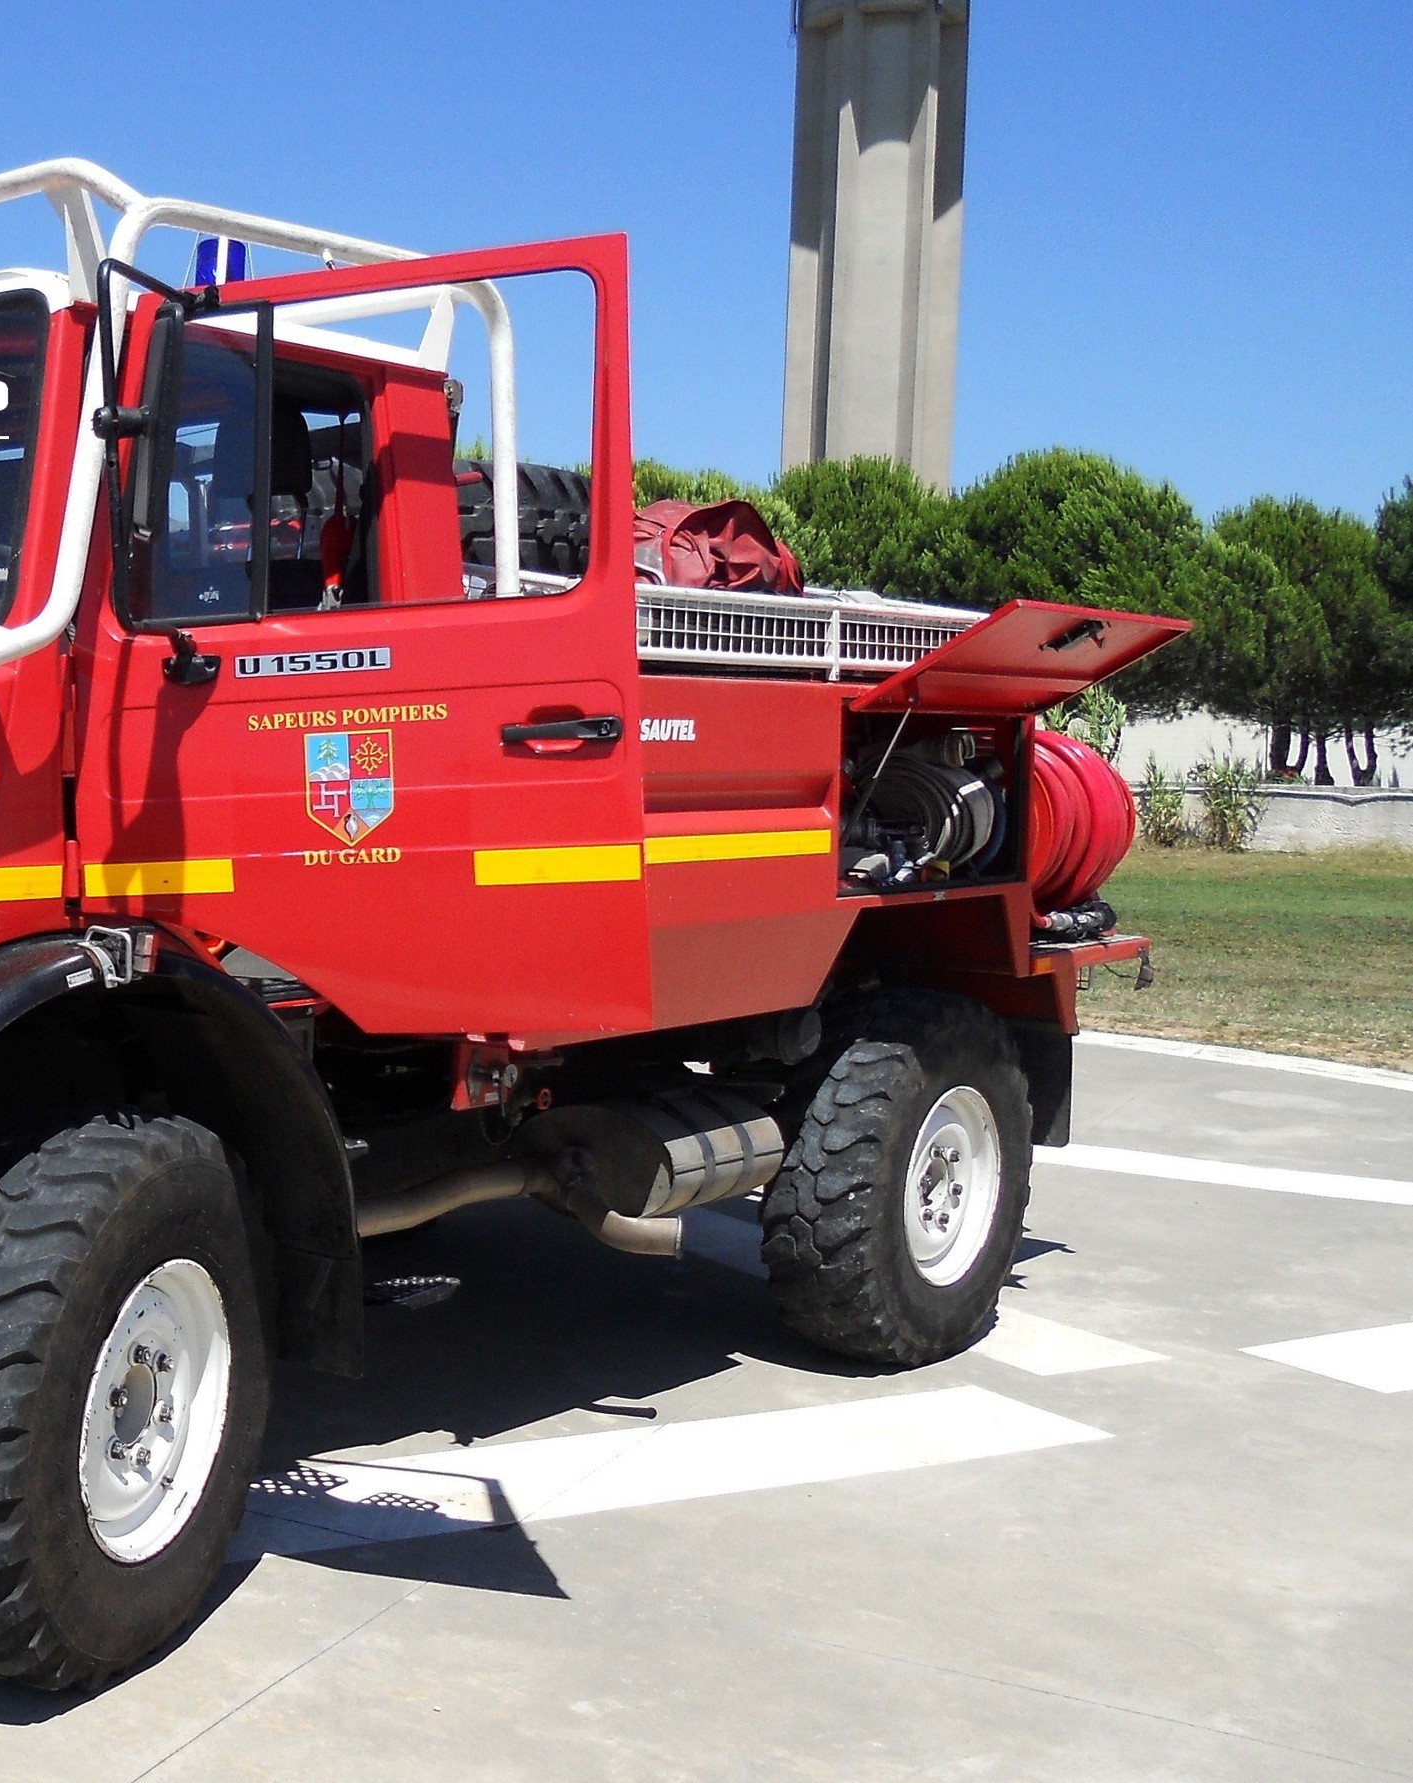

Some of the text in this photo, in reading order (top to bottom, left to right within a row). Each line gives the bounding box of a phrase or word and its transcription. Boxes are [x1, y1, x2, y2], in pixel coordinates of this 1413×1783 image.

[239, 651, 386, 675] U 1550L
[248, 703, 448, 731] SAPEURS POMPIERS
[638, 718, 696, 741] SAUTEL
[304, 847, 402, 866] DU GARD
